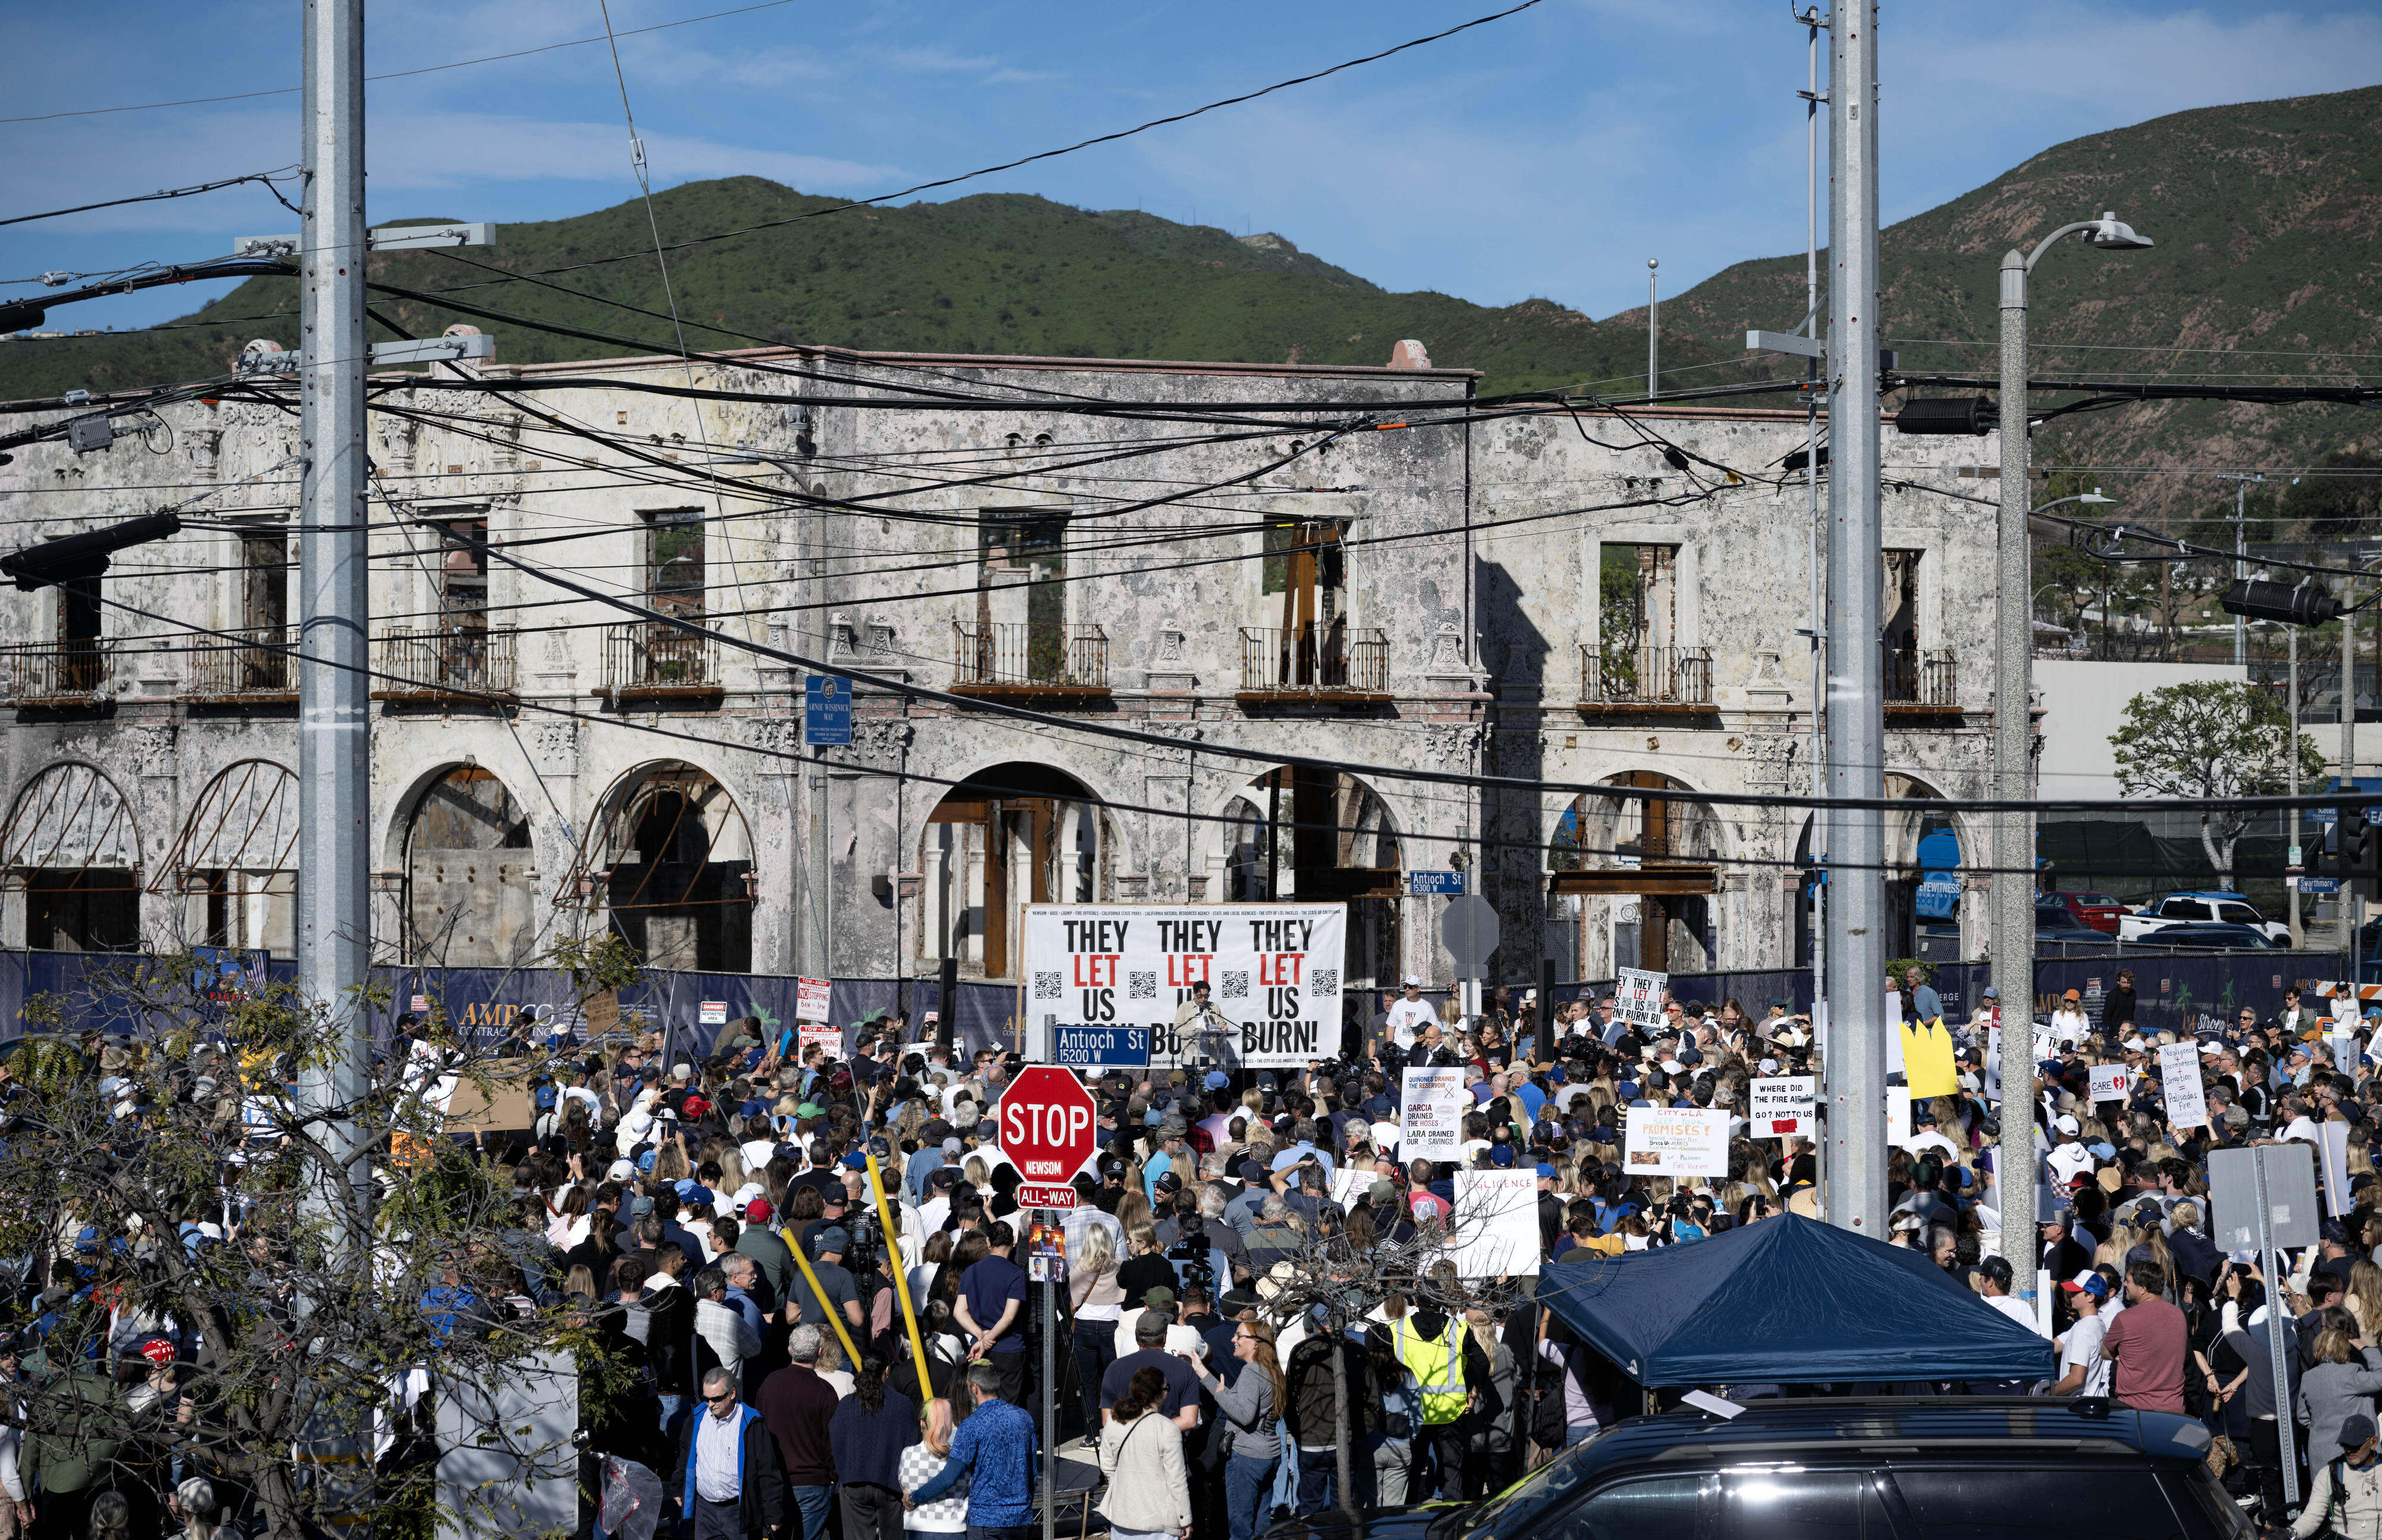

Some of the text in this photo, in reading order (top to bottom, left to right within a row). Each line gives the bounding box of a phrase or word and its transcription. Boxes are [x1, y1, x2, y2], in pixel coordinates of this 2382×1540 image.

[1413, 873, 1461, 885] Antioch St
[1919, 882, 1960, 893] EYEWITNESS
[1063, 921, 1128, 952] THEY
[1157, 921, 1222, 952] THEY
[1249, 919, 1314, 951] THEY
[1074, 955, 1120, 987] LET
[1168, 955, 1213, 986] LET
[1260, 953, 1304, 985] LET
[1634, 978, 1653, 990] THEY
[799, 989, 828, 1002] NO STOPPING
[1634, 989, 1648, 1000] LET
[1939, 993, 1959, 1001] ERGE
[1083, 988, 1115, 1021] US
[1268, 987, 1299, 1019] US
[1635, 1000, 1645, 1011] US
[1626, 1009, 1648, 1022] BURN!
[2197, 1014, 2226, 1036] Strong
[801, 1037, 813, 1046] NO
[1060, 1029, 1144, 1050] Antioch St
[1242, 1021, 1317, 1053] BURN!
[1060, 1049, 1101, 1063] 15200 W
[2164, 1046, 2195, 1059] Negligence
[2163, 1059, 2197, 1071] Incompetence
[2092, 1081, 2112, 1091] CARE
[2165, 1074, 2192, 1085] Corruption
[2168, 1093, 2197, 1103] Palisades
[2179, 1101, 2191, 1111] Fire
[1006, 1102, 1089, 1147] STOP
[1026, 1161, 1061, 1175] NEWSOM
[1461, 1179, 1531, 1191] NEGLIGENCE
[1021, 1190, 1073, 1205] ALL-WAY
